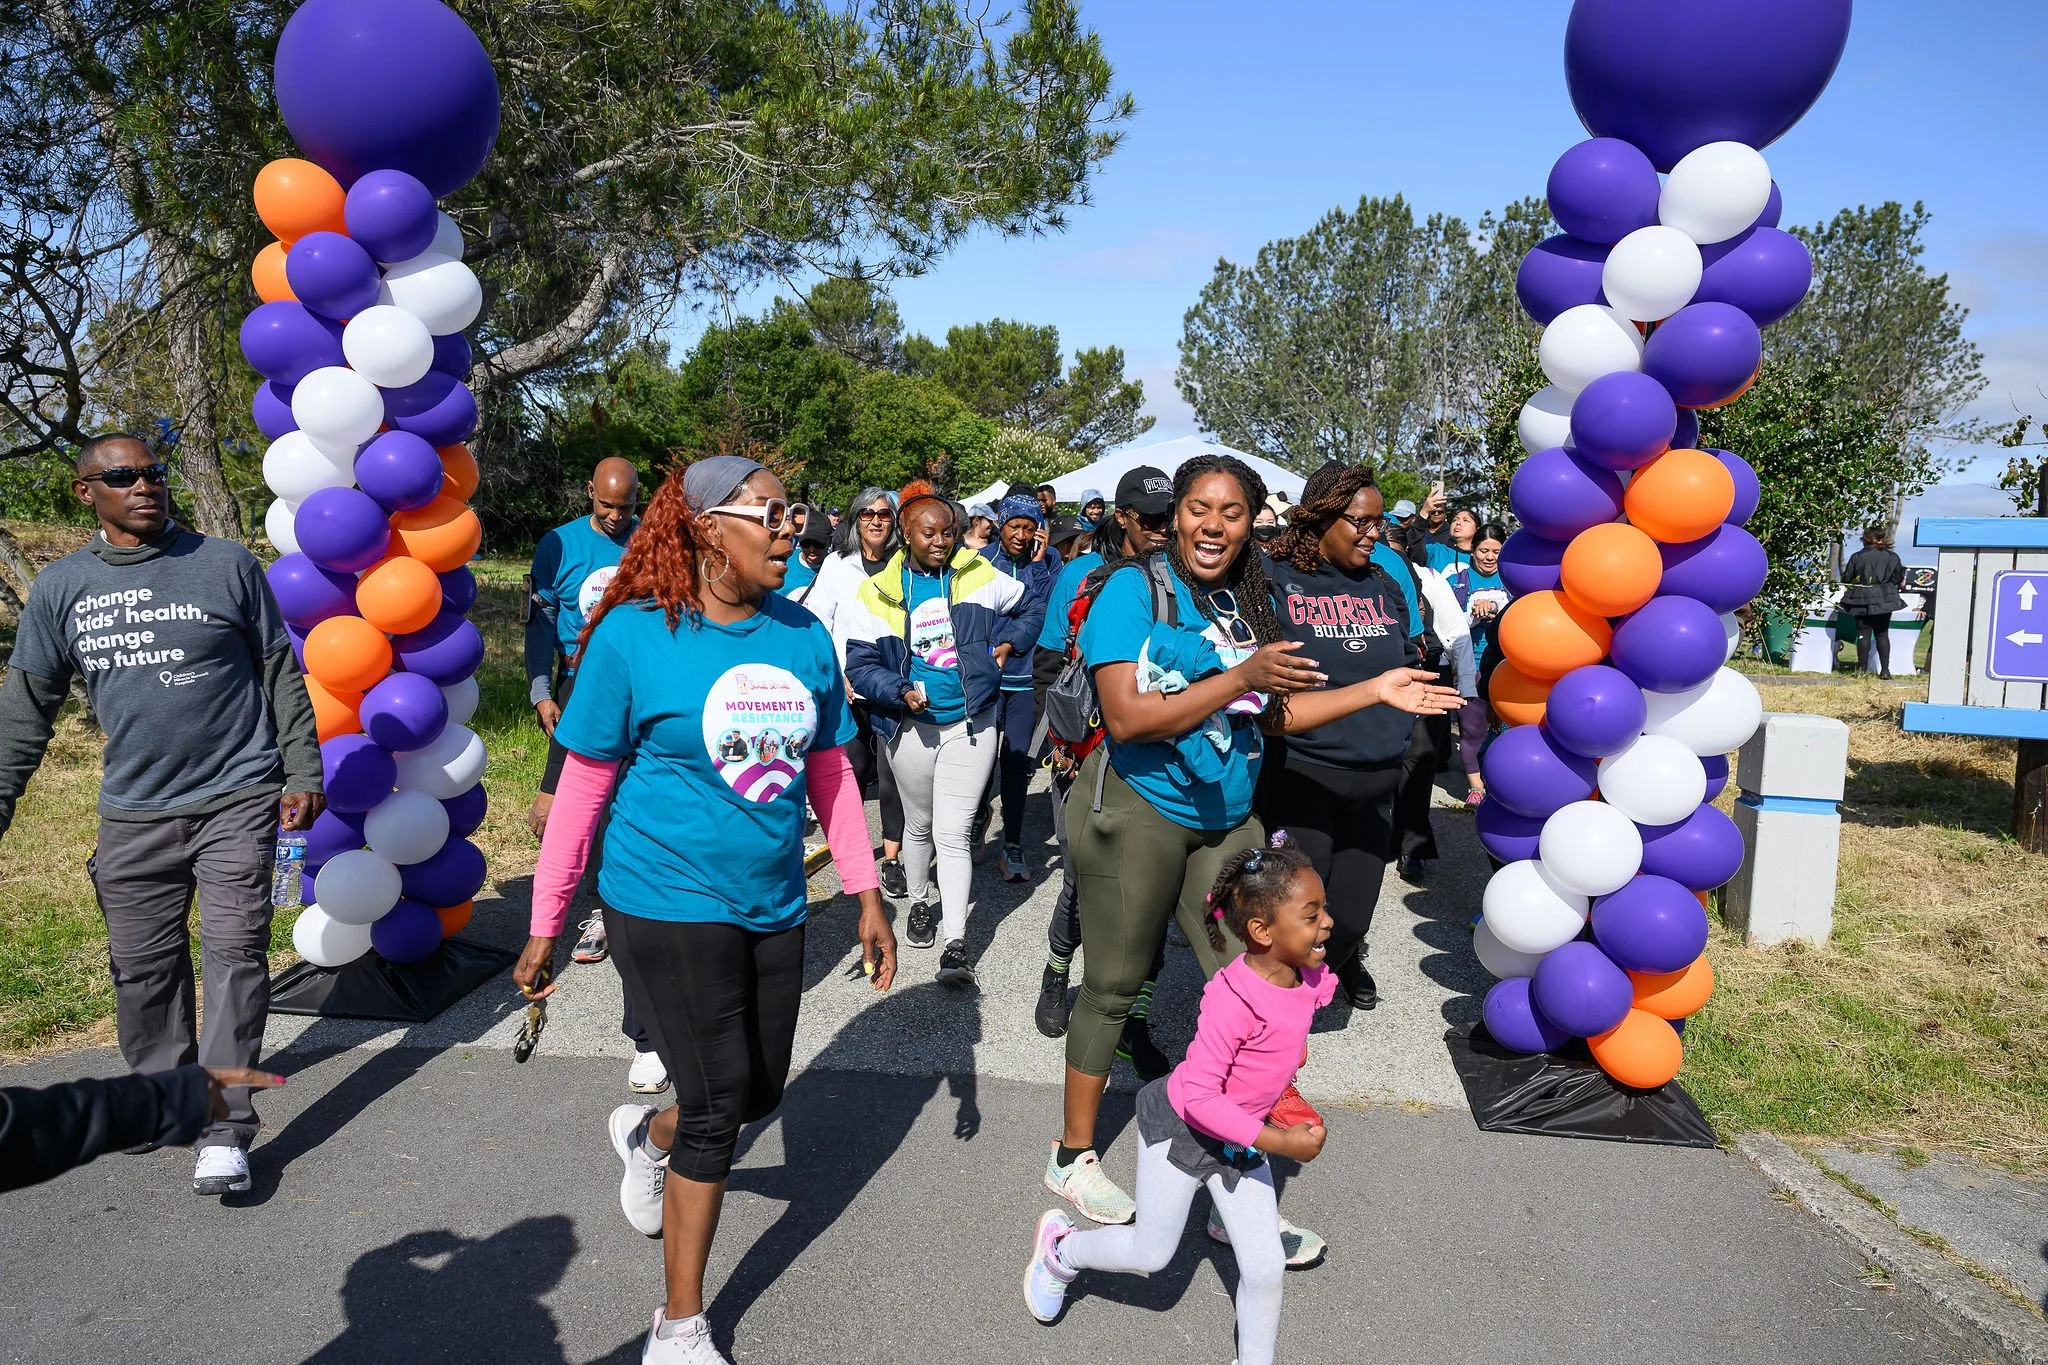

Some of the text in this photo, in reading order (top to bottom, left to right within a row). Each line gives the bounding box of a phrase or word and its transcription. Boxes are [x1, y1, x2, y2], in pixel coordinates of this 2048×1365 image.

[75, 588, 153, 613] change
[75, 603, 208, 633] kids' health,
[78, 630, 155, 652] change
[1313, 625, 1389, 638] BULLDOGS
[83, 648, 185, 671] the future
[725, 701, 805, 711] MOVEMENT IS
[732, 713, 804, 723] RESISTANCE
